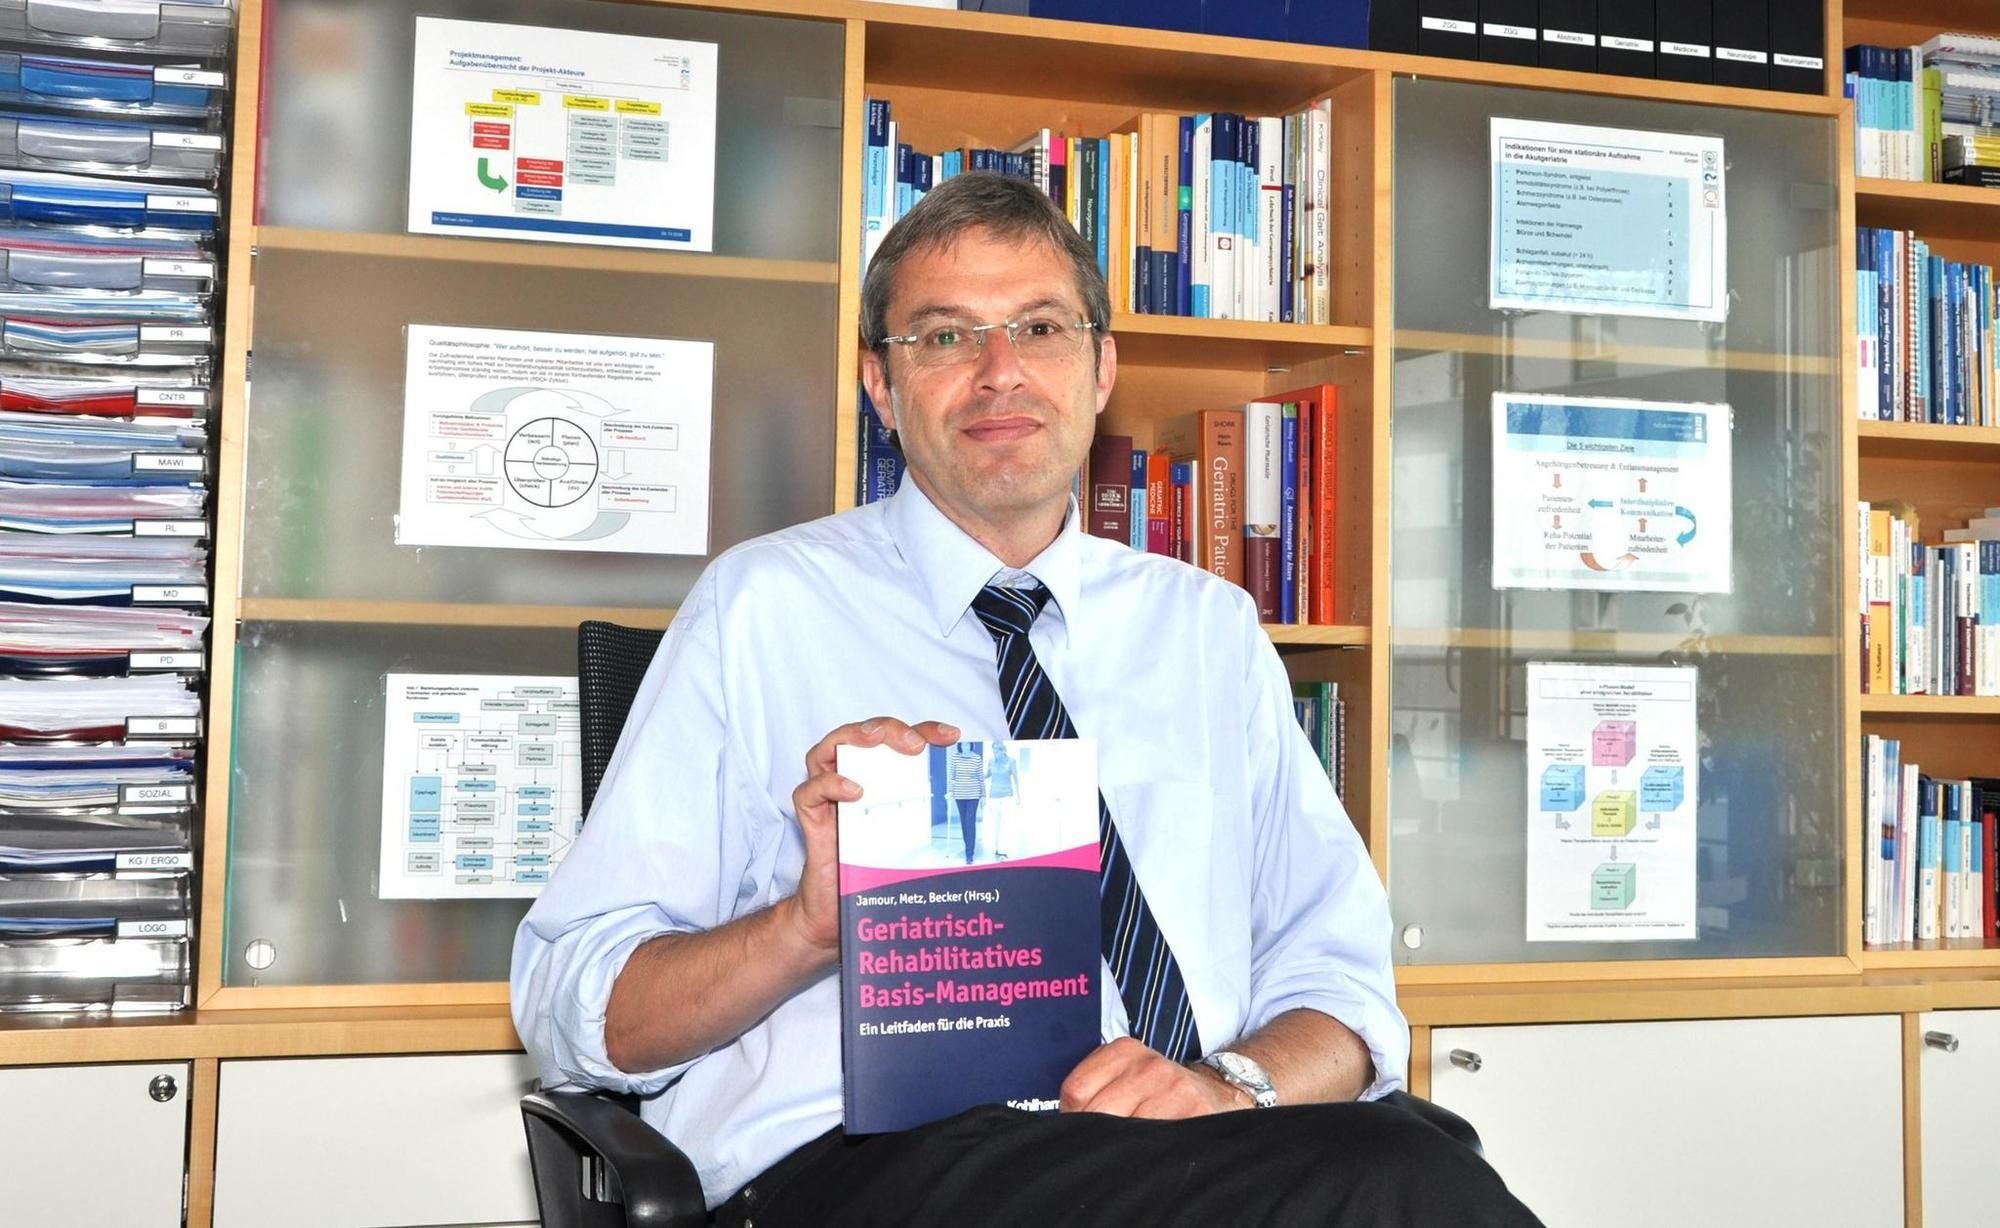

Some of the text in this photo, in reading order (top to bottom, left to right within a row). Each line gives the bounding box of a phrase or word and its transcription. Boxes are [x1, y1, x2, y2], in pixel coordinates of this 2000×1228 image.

[182, 136, 194, 145] KL
[1505, 143, 1546, 153] Indikationen
[1574, 149, 1606, 158] stationäre
[1608, 151, 1641, 160] Aufnahme
[1525, 154, 1568, 164] Akutgeriatrie
[1316, 169, 1326, 208] Clinical
[176, 199, 190, 208] KH
[1085, 198, 1094, 242] Neurogeriatrie
[1316, 212, 1326, 236] Gait
[1180, 212, 1189, 264] Gerontopsychiatrie
[1316, 240, 1326, 286] Analysis
[174, 264, 184, 273] PL
[170, 330, 184, 338] PR
[159, 392, 186, 401] CNTR
[158, 458, 184, 467] MAWI
[877, 458, 886, 501] GERIATR
[1212, 456, 1230, 577] Geriatric Patie
[165, 524, 176, 532] RL
[163, 590, 178, 598] MD
[160, 656, 174, 665] PD
[158, 722, 168, 730] BI
[138, 789, 172, 798] SOZIAL
[128, 856, 142, 865] KG
[150, 856, 180, 865] ERGO
[856, 888, 1000, 907] Jamour, Metz, Becker (Hrsg.)
[138, 924, 166, 933] LOGO
[857, 912, 1005, 942] Geriatrisch-
[859, 945, 1043, 976] Rehabilitatives
[860, 973, 1089, 1008] Basis-Management
[860, 1014, 1010, 1036] Ein Leitfaden für die Praxis
